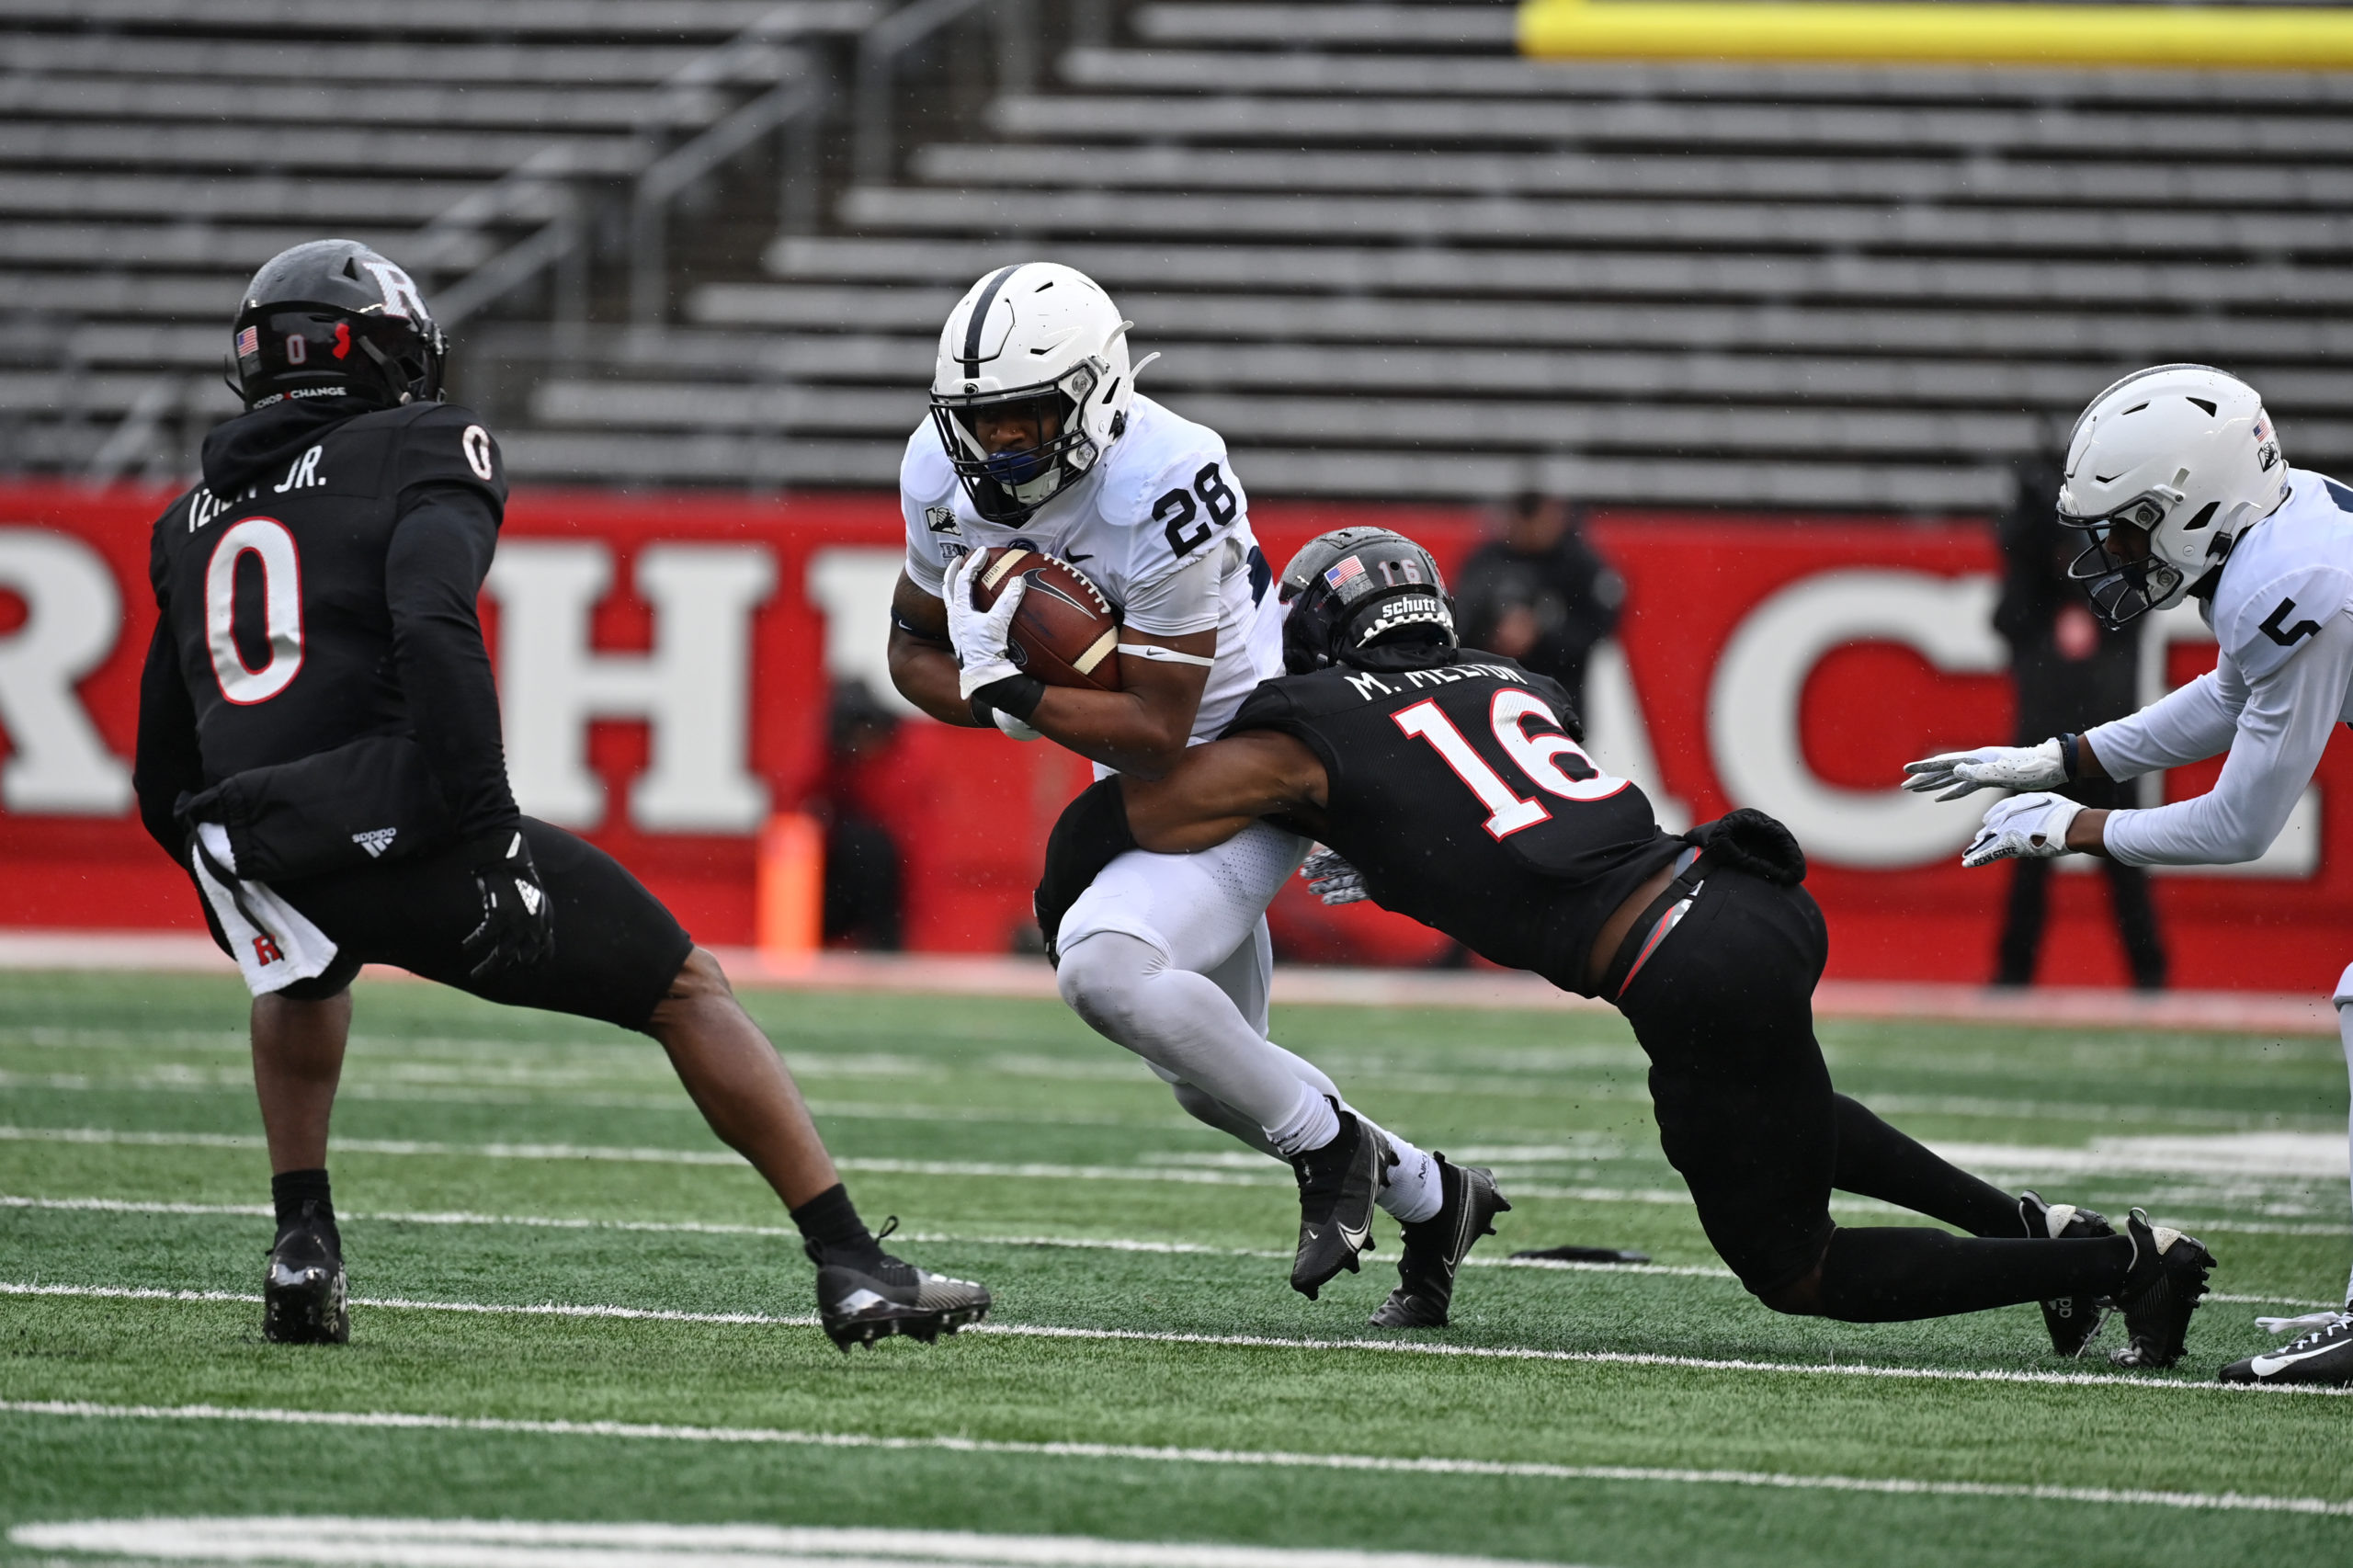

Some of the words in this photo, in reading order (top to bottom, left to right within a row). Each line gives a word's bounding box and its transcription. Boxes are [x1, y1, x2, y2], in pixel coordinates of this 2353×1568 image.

[360, 260, 431, 320] R
[286, 334, 306, 365] 0
[273, 445, 326, 493] JR.
[462, 425, 492, 481] 0
[1152, 462, 1236, 559] 28
[1378, 559, 1422, 587] 16
[205, 517, 304, 705] 0
[1382, 597, 1437, 619] schutt
[2258, 597, 2322, 646] 5
[1344, 672, 1403, 700] M.
[1389, 687, 1631, 842] 16
[352, 827, 396, 843] adidas
[1973, 853, 1994, 866] PENN
[1993, 846, 2018, 858] STATE
